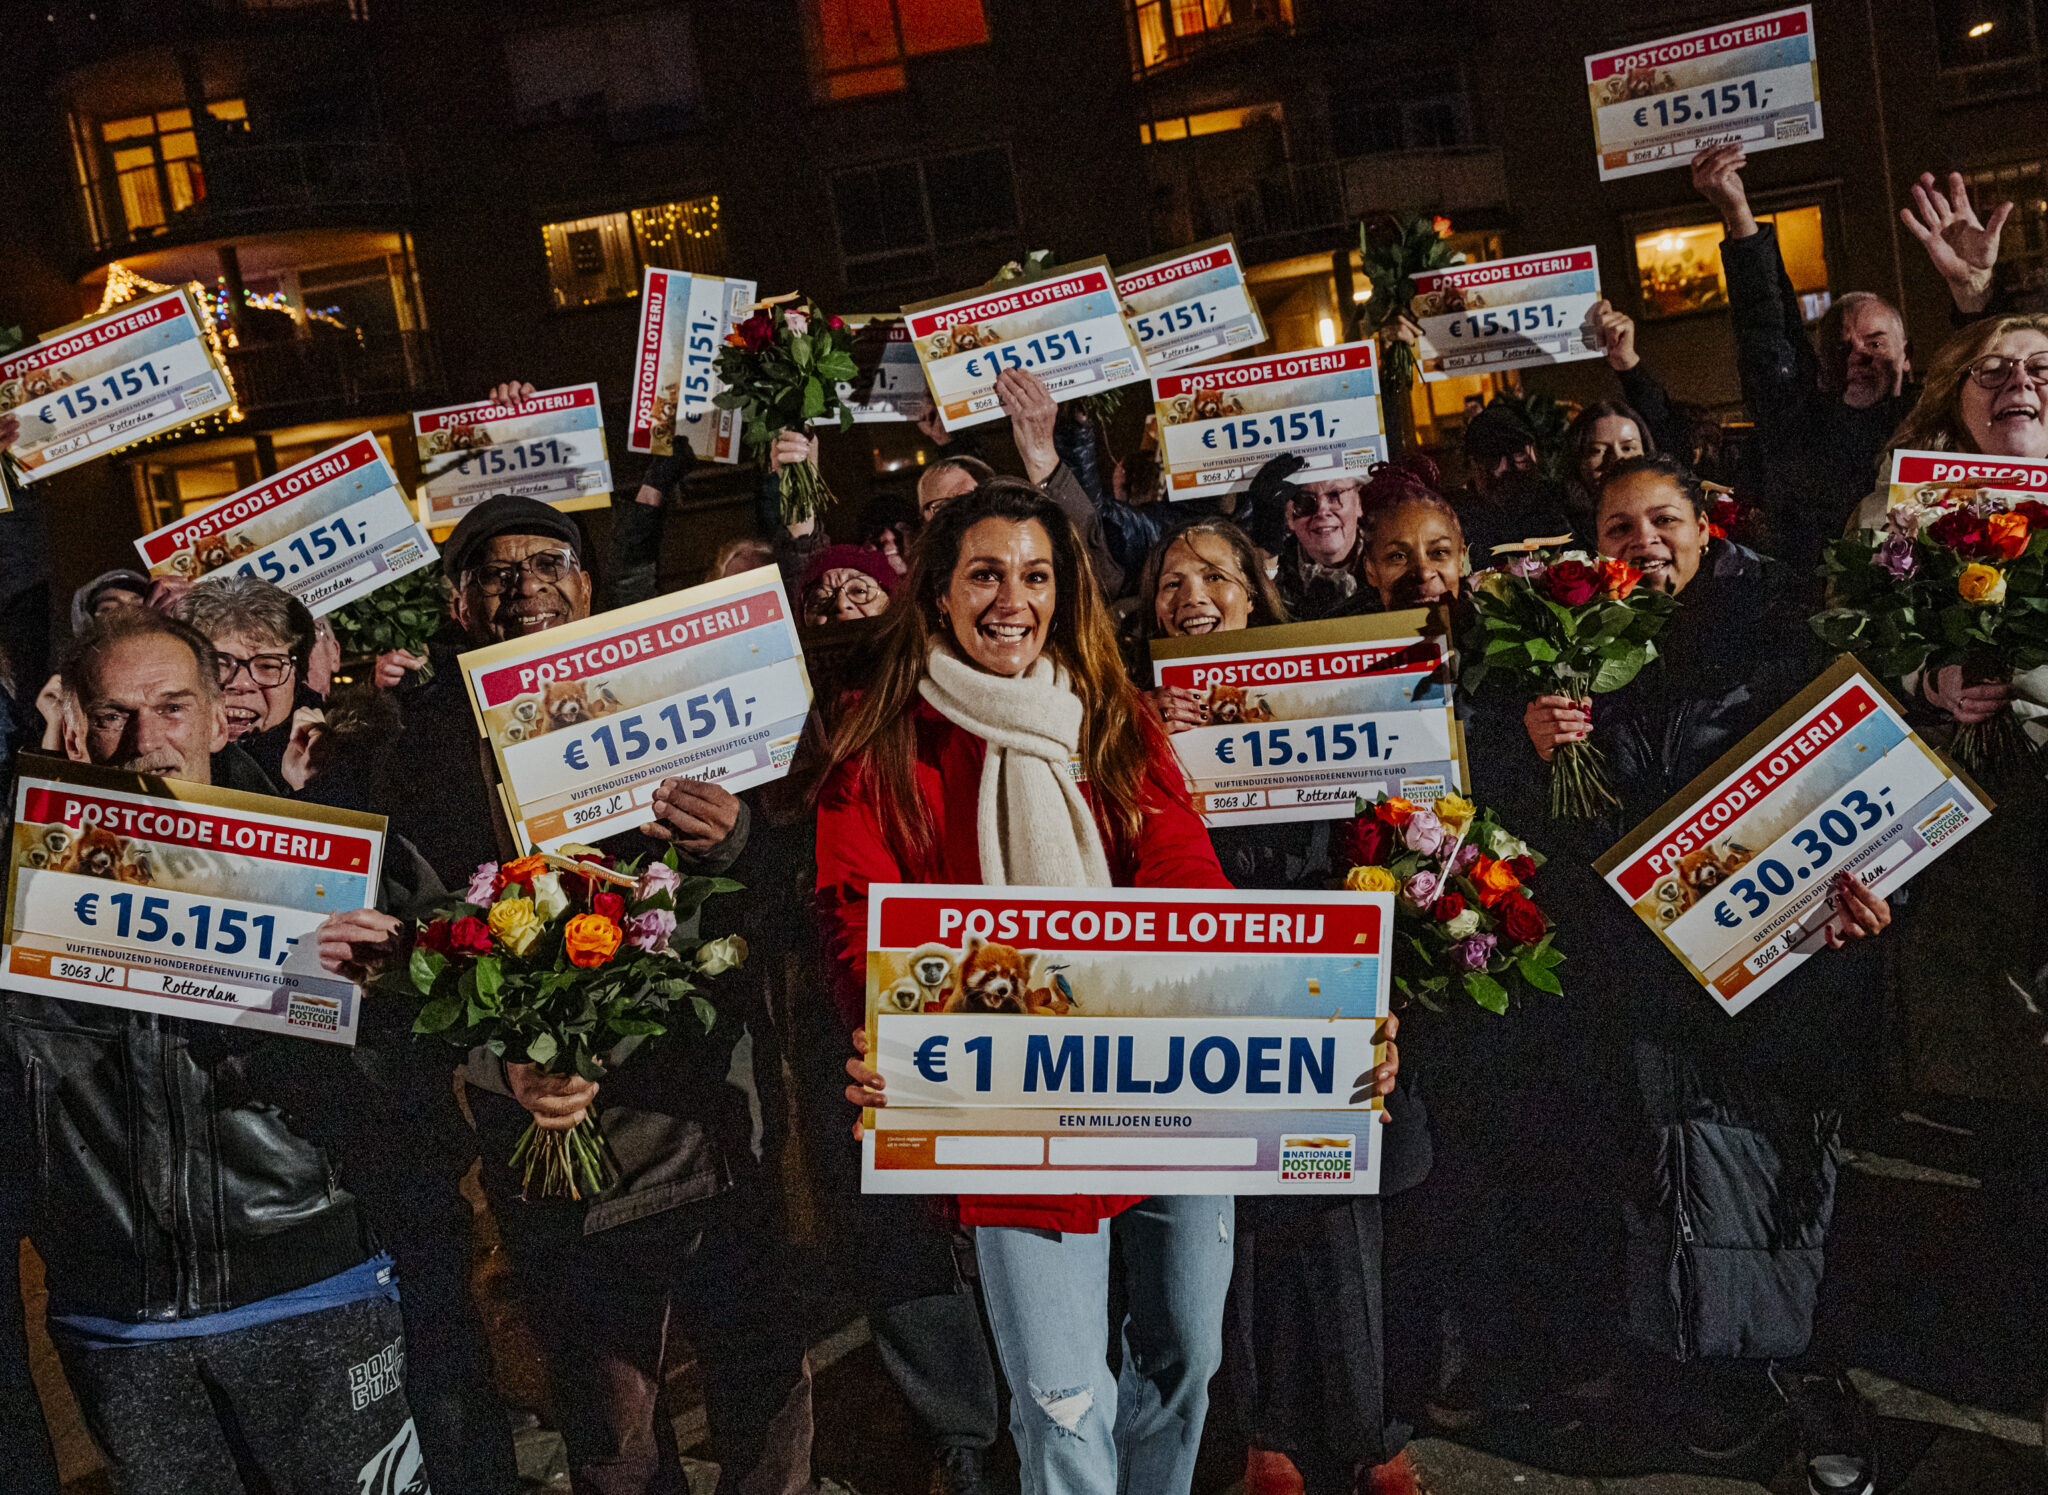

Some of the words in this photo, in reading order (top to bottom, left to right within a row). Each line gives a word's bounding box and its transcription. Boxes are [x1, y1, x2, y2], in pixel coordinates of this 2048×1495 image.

[1614, 40, 1706, 72] POSTCODE
[1709, 21, 1781, 49] LOTERIJ
[1118, 271, 1155, 295] CODE
[1156, 256, 1213, 281] LOTERIJ
[1432, 266, 1511, 290] POSTCODE
[1514, 257, 1573, 277] LOTERIJ
[646, 291, 664, 351] LOTERIJ
[934, 296, 1021, 330] POSTCODE
[1023, 279, 1085, 307] LOTERIJ
[1128, 301, 1218, 343] 5.151,-
[4, 329, 95, 379] POSTCODE
[96, 307, 163, 343] LOTERIJ
[1181, 364, 1273, 392] POSTCODE
[1277, 353, 1346, 377] LOTERIJ
[637, 351, 657, 429] POSTCODE
[108, 411, 155, 434] Rotterdam
[438, 406, 516, 428] POSTCODE
[518, 394, 575, 415] LOTERIJ
[171, 490, 276, 548] POSTCODE
[274, 454, 351, 501] LOTERIJ
[301, 575, 353, 605] Rotterdam
[519, 633, 654, 690] POSTCODE
[656, 604, 752, 649] LOTERIJ
[1192, 659, 1314, 686] POSTCODE
[570, 769, 648, 802] VIJFTIENDUIZEND
[747, 729, 770, 744] EURO
[1214, 776, 1285, 788] VIJFTIENDUIZEND
[1384, 767, 1407, 776] EURO
[573, 805, 602, 824] 3063
[606, 794, 624, 815] JC
[1213, 796, 1239, 809] 3063
[1242, 793, 1258, 808] JC
[1296, 787, 1358, 803] Rotterdam
[1402, 790, 1444, 799] POSTCODE
[1646, 779, 1762, 875] POSTCODE
[1754, 711, 1844, 786] LOTERIJ
[63, 799, 212, 843] POSTCODE
[220, 826, 331, 861] LOTERIJ
[1925, 810, 1966, 844] POSTCODE
[1753, 894, 1813, 943] DERTIGDUIZEND
[1881, 823, 1904, 843] EURO
[938, 908, 1157, 943] POSTCODE
[1168, 912, 1326, 944] LOTERIJ
[66, 942, 152, 965] VIJFTIENDUIZEND
[272, 975, 299, 988] EURO
[1753, 945, 1780, 970] 3063
[1781, 929, 1797, 949] JC
[60, 963, 91, 979] 3063
[95, 965, 115, 982] JC
[162, 975, 239, 1004] Rotterdam
[288, 1009, 338, 1025] POSTCODE
[294, 1019, 331, 1030] LOTERIJ
[295, 1004, 333, 1016] NATIONALE
[1022, 1034, 1336, 1095] MILJOEN
[1058, 1115, 1087, 1127] EEN
[1089, 1115, 1152, 1128] MILJOEN
[1154, 1115, 1192, 1128] EURO
[1282, 1159, 1352, 1172] POSTCODE
[1291, 1150, 1344, 1159] NATIONALE
[1290, 1171, 1343, 1180] LOTERIJ
